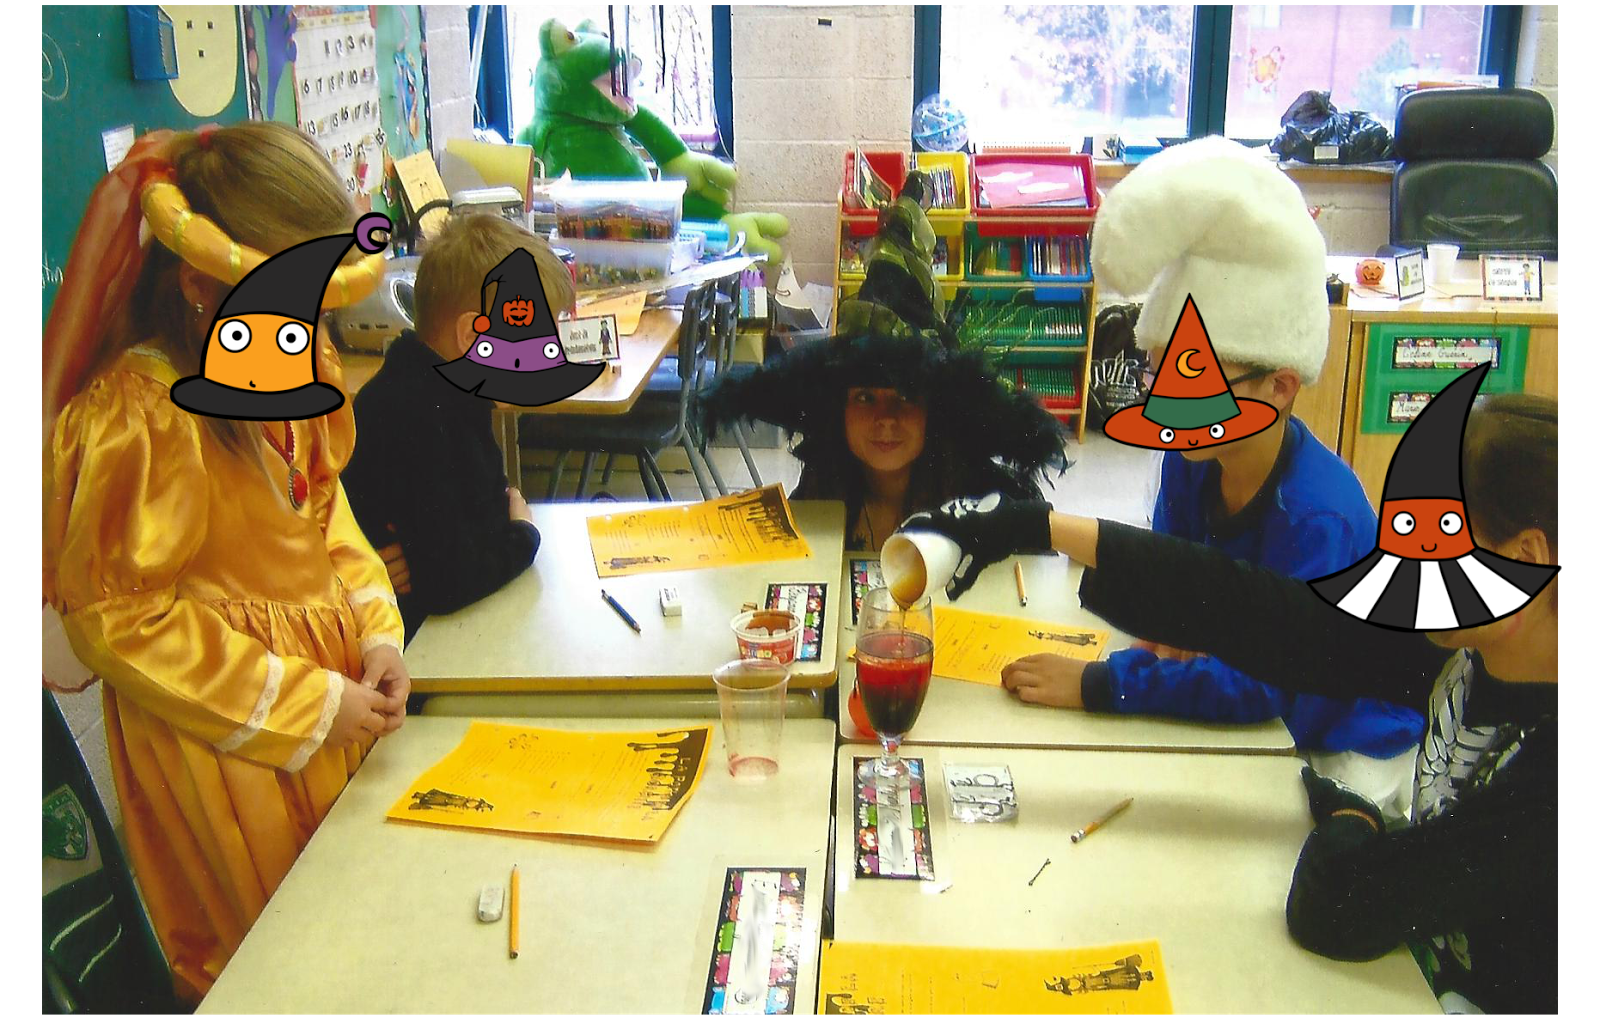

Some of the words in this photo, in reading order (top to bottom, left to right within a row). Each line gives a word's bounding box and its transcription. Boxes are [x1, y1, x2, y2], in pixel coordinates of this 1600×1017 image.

[346, 35, 355, 49] 3
[303, 79, 310, 94] 6
[349, 69, 358, 85] 10
[306, 119, 316, 135] 13
[341, 106, 349, 121] 16
